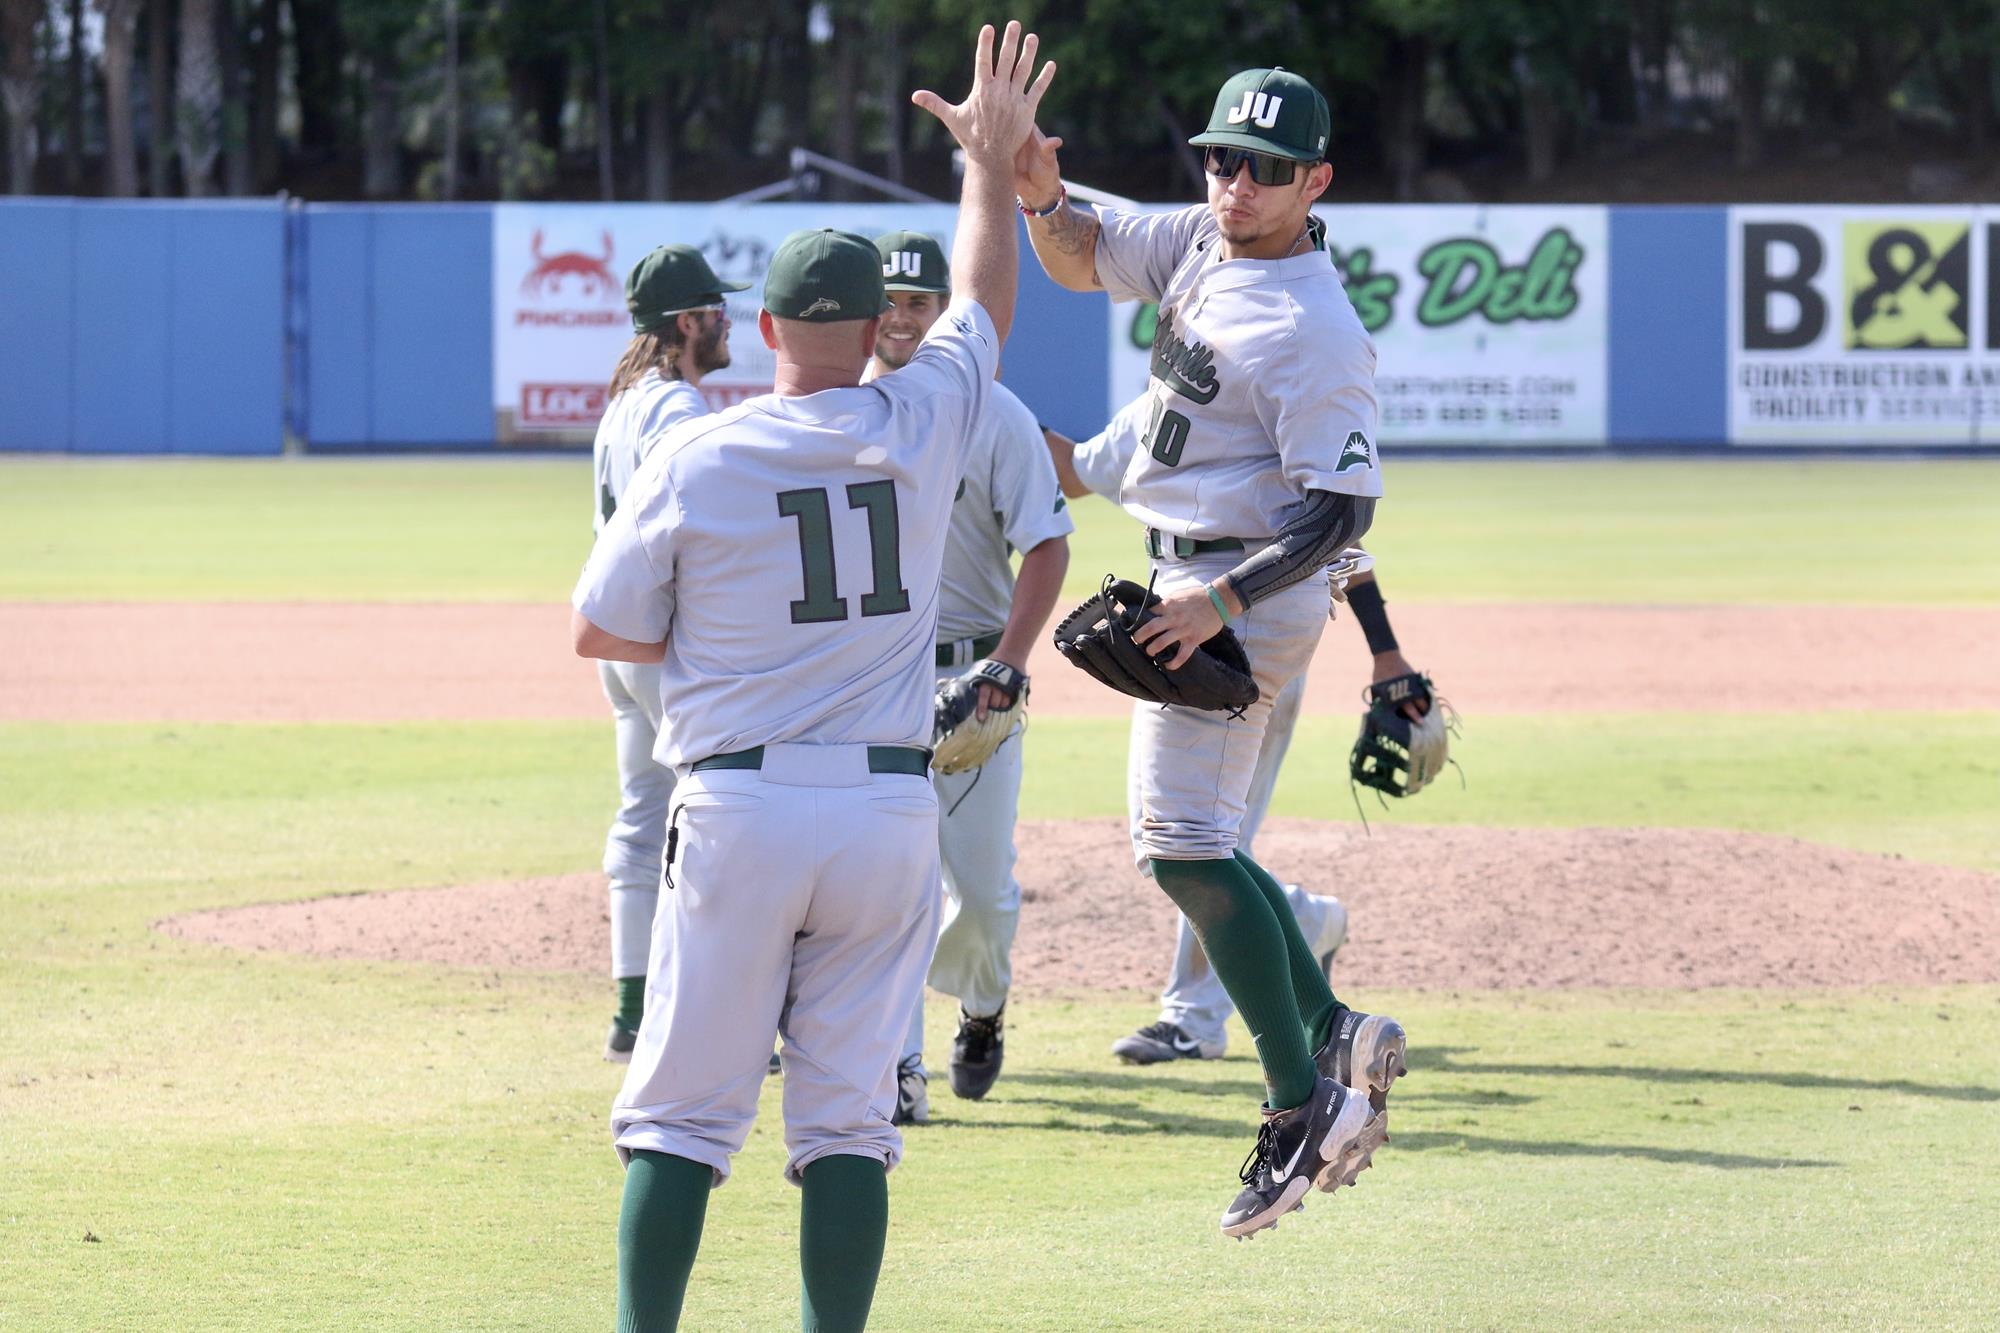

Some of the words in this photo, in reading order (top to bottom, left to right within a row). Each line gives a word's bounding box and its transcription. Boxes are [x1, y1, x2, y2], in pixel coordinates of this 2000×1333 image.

[1227, 91, 1283, 129] JU
[882, 251, 922, 278] JU
[1416, 228, 1585, 327] Deli
[1741, 363, 1950, 387] CONSTRUCTION
[1750, 396, 1868, 419] FACILITY
[777, 479, 911, 624] 11
